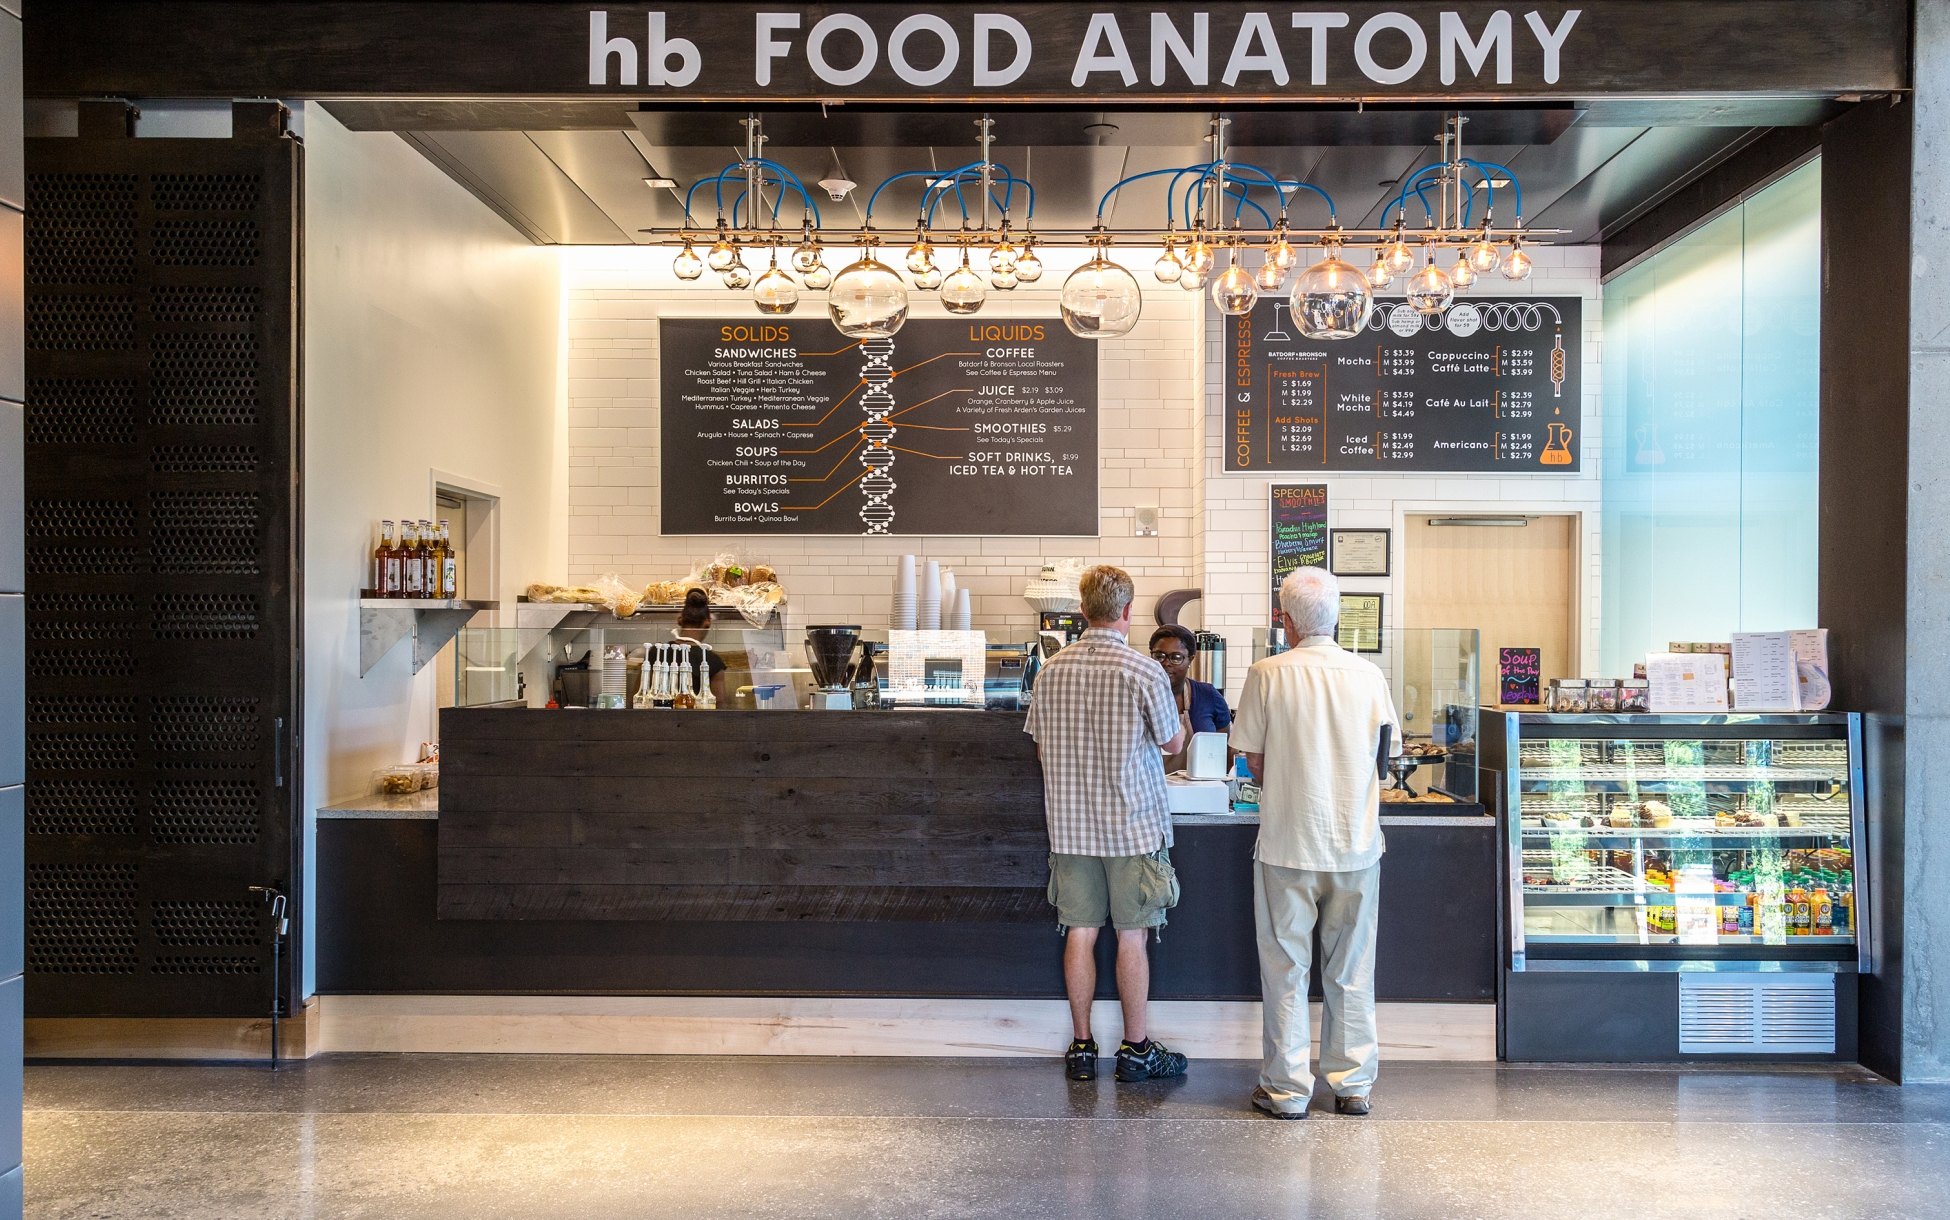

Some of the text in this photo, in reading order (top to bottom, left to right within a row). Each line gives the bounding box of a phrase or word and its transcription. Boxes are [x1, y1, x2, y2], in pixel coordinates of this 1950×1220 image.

[587, 9, 1581, 87] hb FOOD ANATOMY
[721, 326, 789, 342] SOLIDS
[970, 326, 1045, 341] LIQUIDS
[714, 348, 797, 359] SANDWICHES
[986, 348, 1035, 358] COFFEE
[1428, 351, 1490, 360] Cappuccino
[1337, 357, 1371, 365] Mocha
[1464, 364, 1489, 372] Latte
[978, 386, 1063, 395] JUICE $2.19 $3.09
[967, 398, 994, 406] Orange,
[995, 398, 1028, 406] Cranberry
[1036, 398, 1055, 406] Apple
[1426, 399, 1489, 407] Café Au Lait
[732, 419, 779, 429] SALADS
[974, 424, 1072, 434] SMOOTHIES $5.29
[697, 431, 722, 439] Arugula
[755, 431, 780, 439] Spinach
[787, 431, 813, 439] Caprese
[1237, 409, 1250, 467] COFFEE
[1346, 435, 1367, 443] Iced
[1434, 440, 1489, 448] Americano
[736, 447, 778, 456] SOUPS
[1340, 446, 1374, 454] Coffee
[968, 452, 1079, 463] SOFT DRINKS, $1.99
[1550, 452, 1563, 462] hb
[949, 465, 1073, 475] ICED TEA & HOT TEA
[726, 475, 787, 485] BURRITOS
[1274, 489, 1325, 498] SPECIALS
[734, 503, 779, 513] BOWLS
[1501, 650, 1537, 665] Soup
